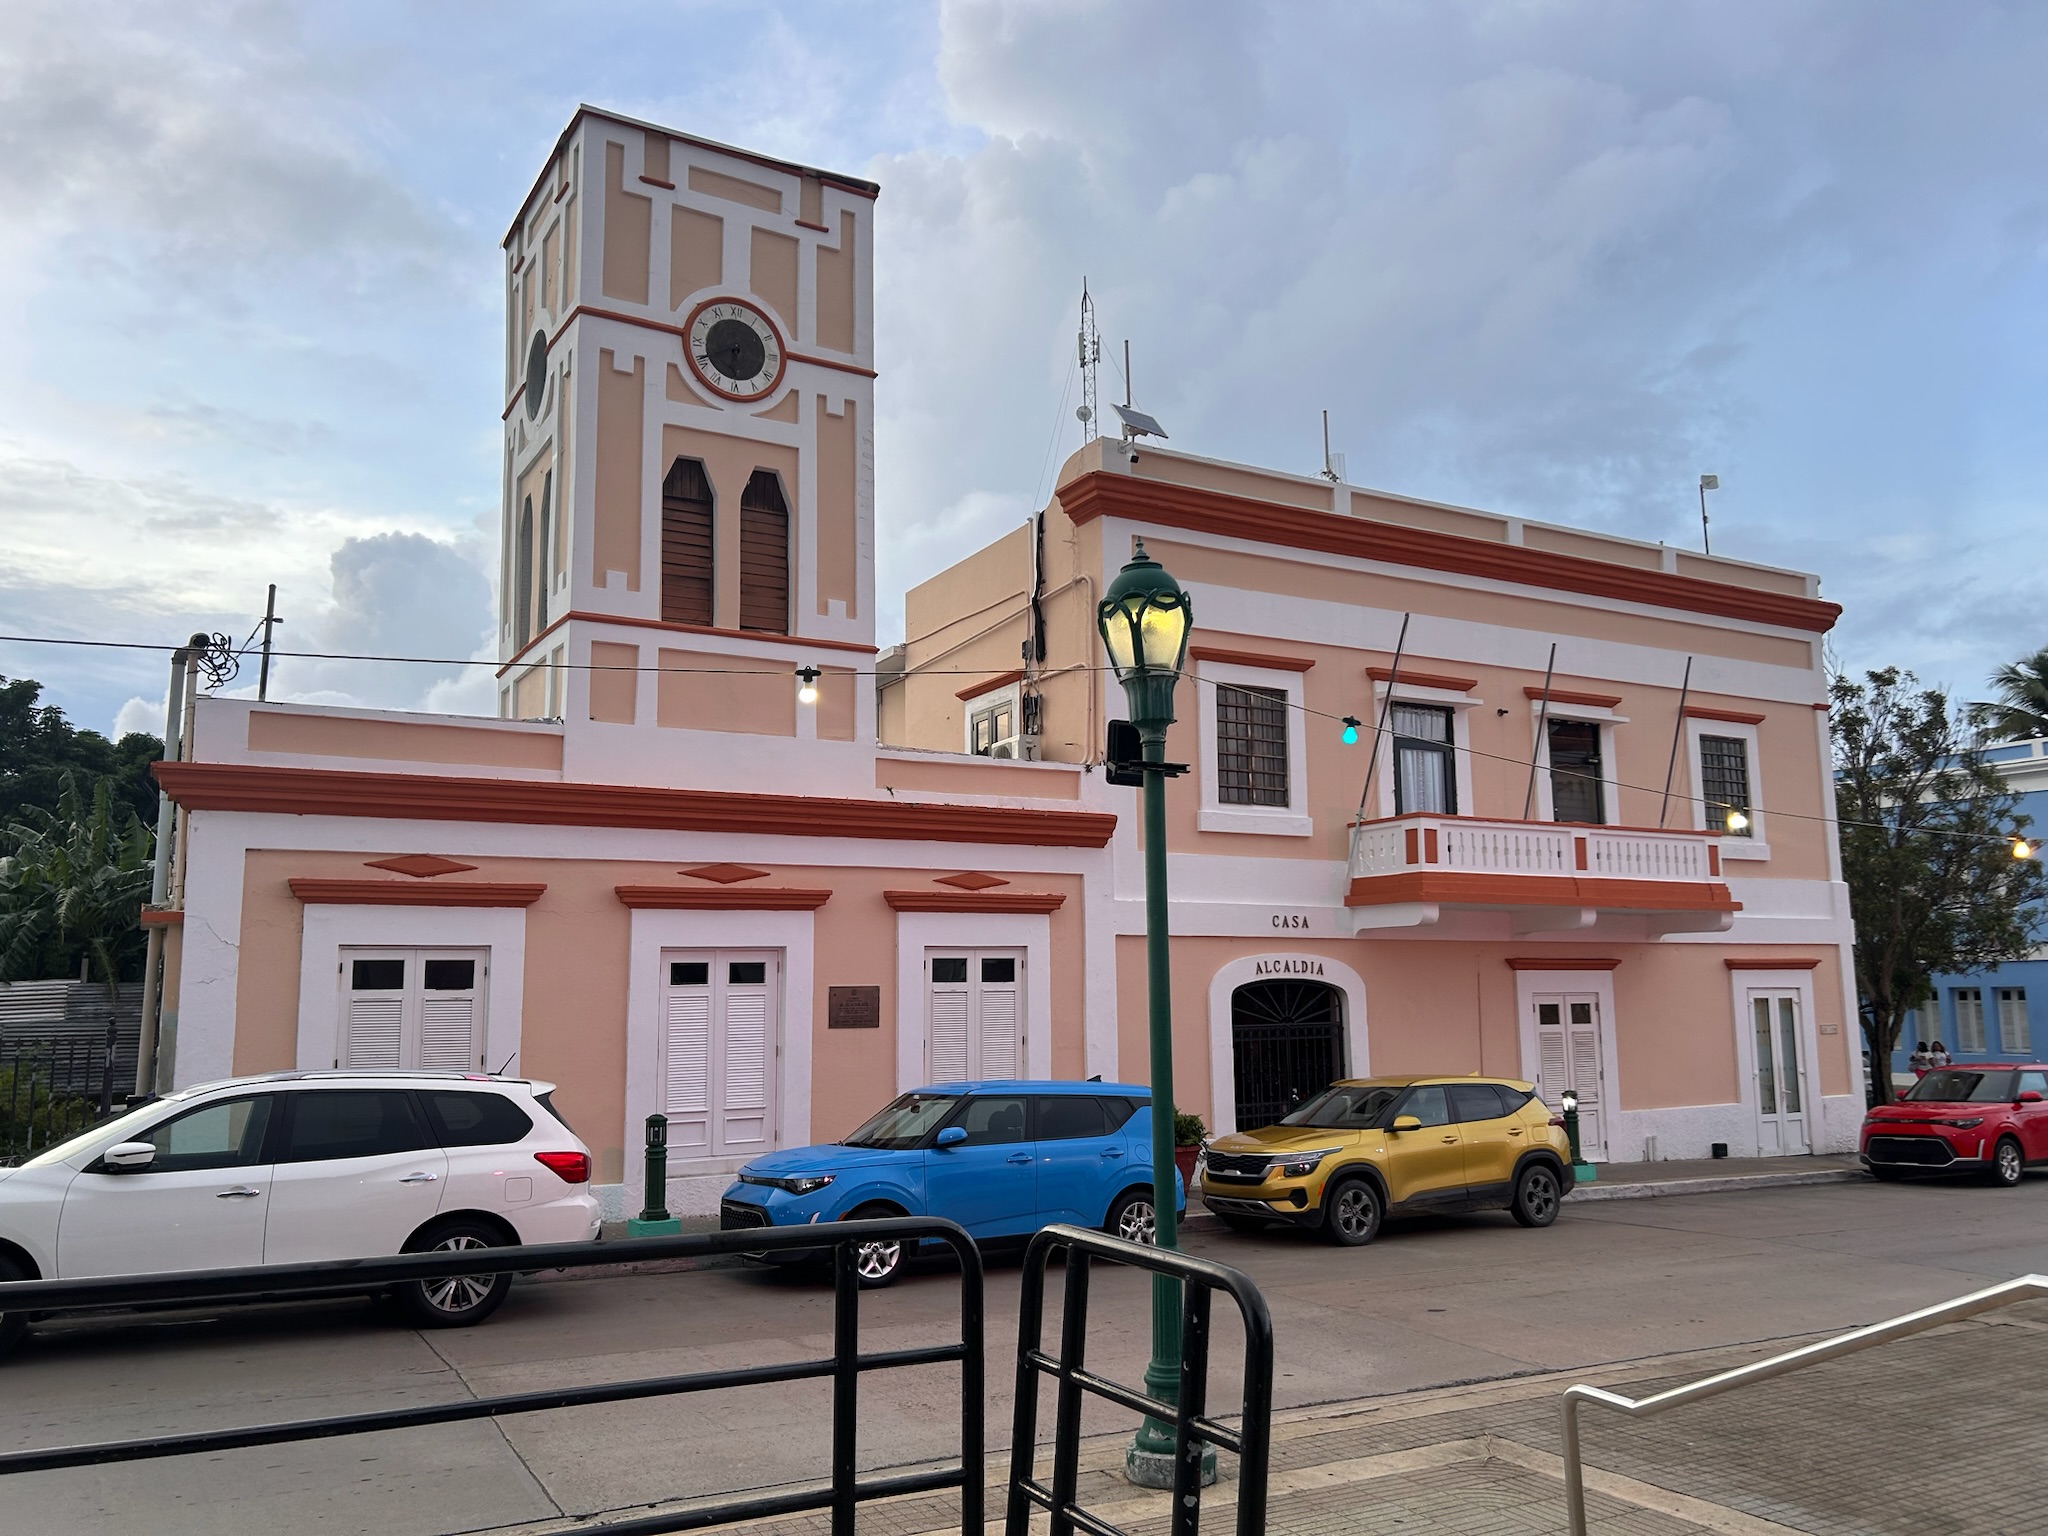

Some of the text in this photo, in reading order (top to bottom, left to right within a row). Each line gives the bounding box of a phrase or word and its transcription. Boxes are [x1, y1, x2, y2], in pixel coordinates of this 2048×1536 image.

[712, 307, 723, 319] XI
[730, 307, 742, 319] XII
[698, 318, 709, 328] X
[692, 336, 704, 347] IX
[1272, 915, 1309, 929] CASA
[1256, 960, 1323, 976] ALCALDIA
